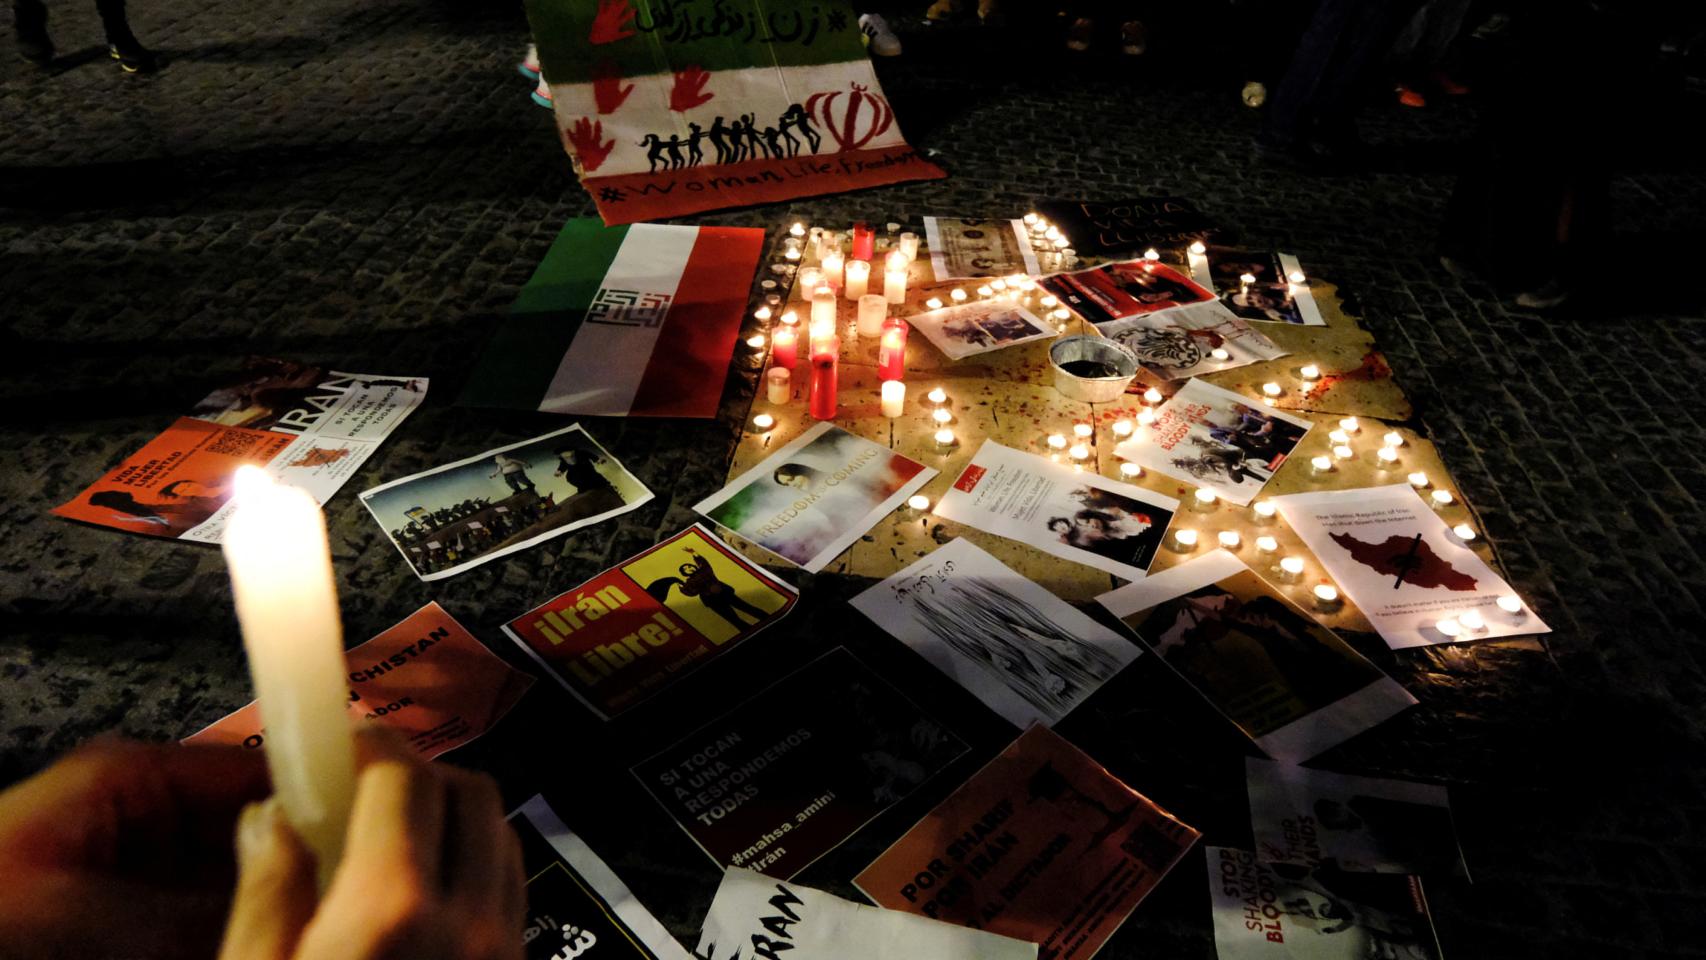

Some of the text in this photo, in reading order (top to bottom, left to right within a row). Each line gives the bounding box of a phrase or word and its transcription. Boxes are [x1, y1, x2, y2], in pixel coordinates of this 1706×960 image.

[270, 370, 357, 433] IRAN
[344, 393, 369, 417] TOCAN
[347, 386, 399, 438] RESPONDEMOS
[357, 400, 376, 416] UNA
[372, 402, 398, 426] TODAS
[1161, 422, 1191, 451] BLOODY
[111, 465, 140, 482] VIDA
[123, 459, 160, 485] MUJER
[134, 451, 182, 487] LIBERTAD
[755, 492, 821, 538] FREEDOM
[825, 447, 878, 487] COMING
[533, 584, 632, 646] ¡Irán
[350, 626, 450, 683] CHISTAN
[566, 611, 684, 687] Libre!
[659, 731, 743, 787] SI TOCAN
[674, 760, 731, 800] A UNA
[683, 727, 813, 814] RESPONDEMOS
[697, 784, 759, 827] TODAS
[731, 788, 837, 866] #mahsa_amini
[900, 858, 952, 903] POR
[1219, 849, 1240, 898] STOP
[1237, 818, 1300, 933] SHAKING THEIR
[1255, 815, 1323, 944] BLOODY ANDS
[751, 883, 805, 960] RAN
